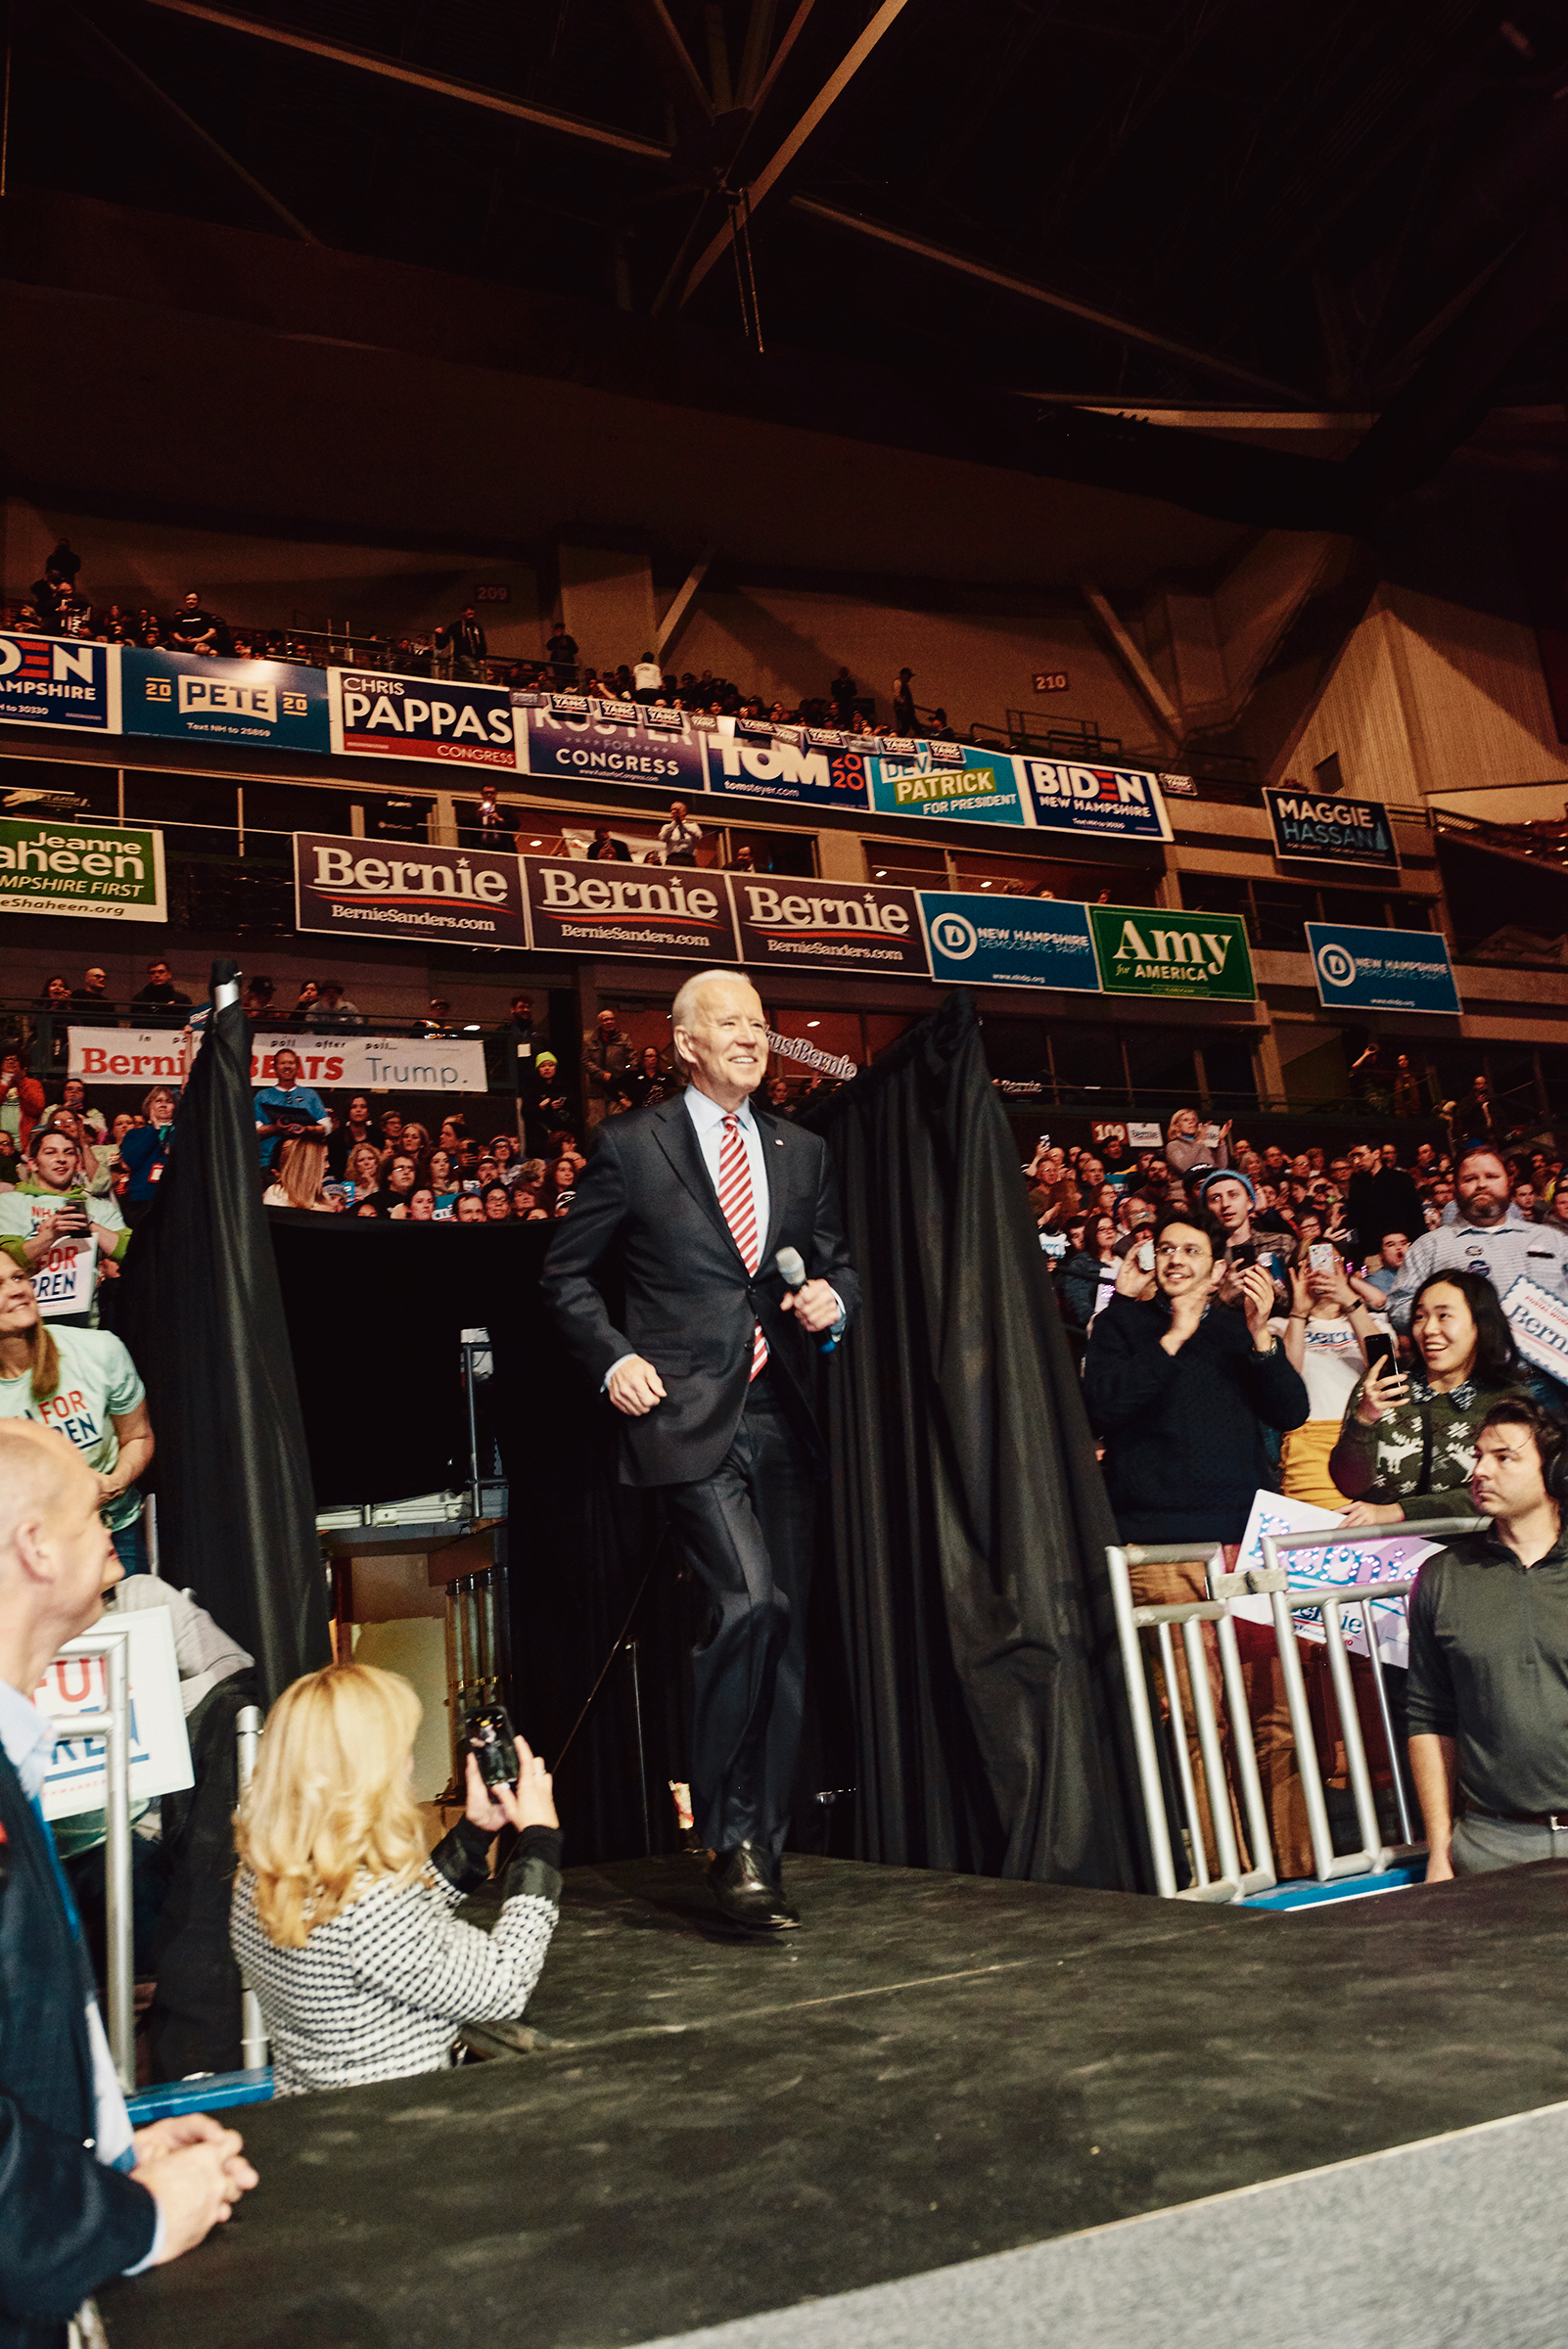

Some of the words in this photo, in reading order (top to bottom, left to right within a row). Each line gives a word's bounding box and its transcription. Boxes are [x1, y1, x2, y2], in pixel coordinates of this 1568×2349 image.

[477, 587, 508, 600] 209
[343, 677, 405, 696] CHRIS
[1036, 674, 1067, 690] 210
[145, 683, 172, 697] 20
[186, 681, 269, 714] PETE
[282, 696, 308, 712] 20
[344, 692, 514, 745] PAPPAS
[437, 745, 515, 765] CONGRESS
[603, 738, 632, 752] FOR
[555, 748, 680, 776] CONGRESS
[708, 734, 831, 788] TOM
[723, 780, 800, 798] tomsteyer.com
[832, 770, 865, 791] 20
[896, 770, 993, 802] PATRICK
[1030, 762, 1146, 805] BIDEN
[922, 801, 949, 815] FOR
[950, 793, 1017, 812] PRESIDENT
[1038, 795, 1071, 809] NEW
[1073, 799, 1152, 818] HAMPSHIRE
[1275, 797, 1374, 828] MAGGIE
[28, 832, 143, 855] Jeanne
[1282, 820, 1374, 849] HASSAN
[0, 841, 145, 880] aheen
[0, 875, 88, 894] MPSHIRE
[90, 881, 145, 898] FIRST
[312, 846, 508, 903] Bernie
[538, 868, 719, 920] Bernie
[331, 903, 496, 932] BernieSanders.com
[744, 885, 910, 935] Bernie
[561, 924, 712, 947] BernieSanders.com
[977, 927, 1010, 941] NEW
[1013, 930, 1090, 947] HAMPSHIRE
[1112, 920, 1233, 976] Amy
[766, 939, 904, 961] BernieSanders.com
[1115, 963, 1131, 977] for
[1134, 964, 1209, 982] AMERICA
[270, 1038, 297, 1048] poll
[314, 1039, 346, 1050] after
[80, 1047, 187, 1077] Berni
[365, 1057, 468, 1088] Trump.
[1093, 1124, 1126, 1142] 109
[37, 1390, 87, 1425] FOR
